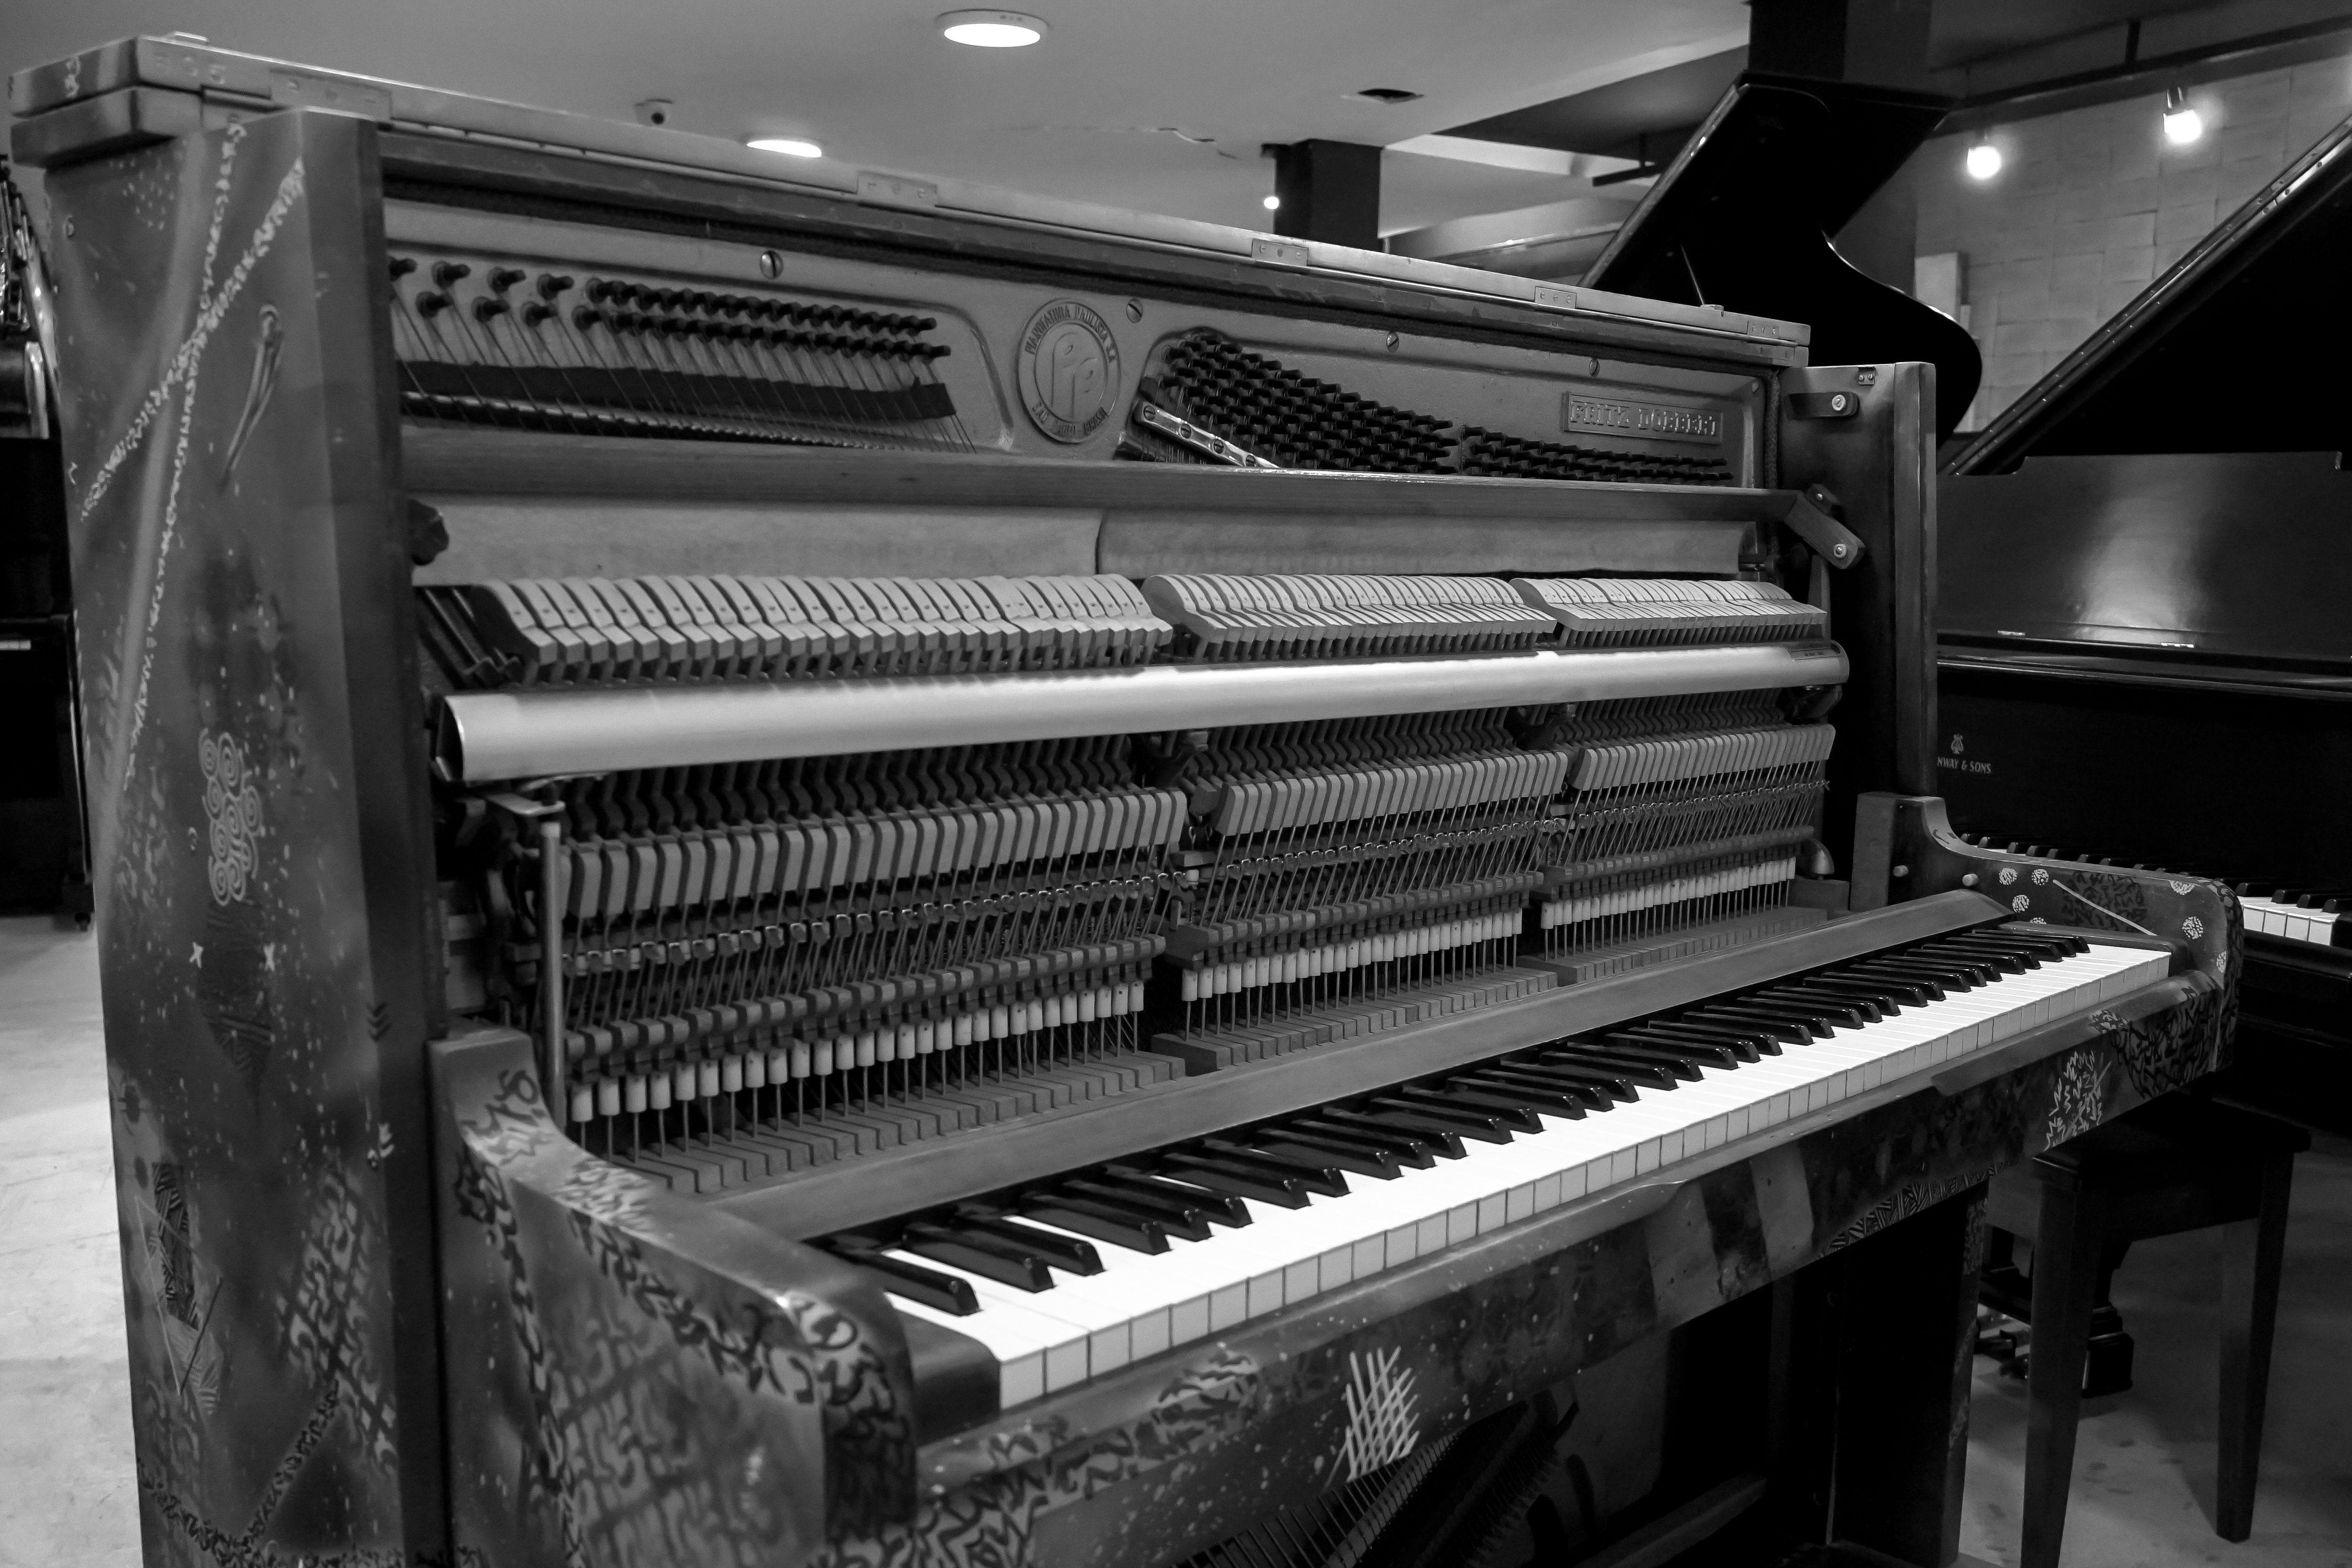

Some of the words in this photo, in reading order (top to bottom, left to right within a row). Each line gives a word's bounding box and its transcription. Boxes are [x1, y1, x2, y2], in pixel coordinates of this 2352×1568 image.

[1570, 400, 1630, 428] FRITZ
[1638, 408, 1717, 436] DOBBERT
[1937, 756, 1959, 769] NWAY
[1961, 760, 1968, 771] &
[1969, 761, 1992, 774] SONS
